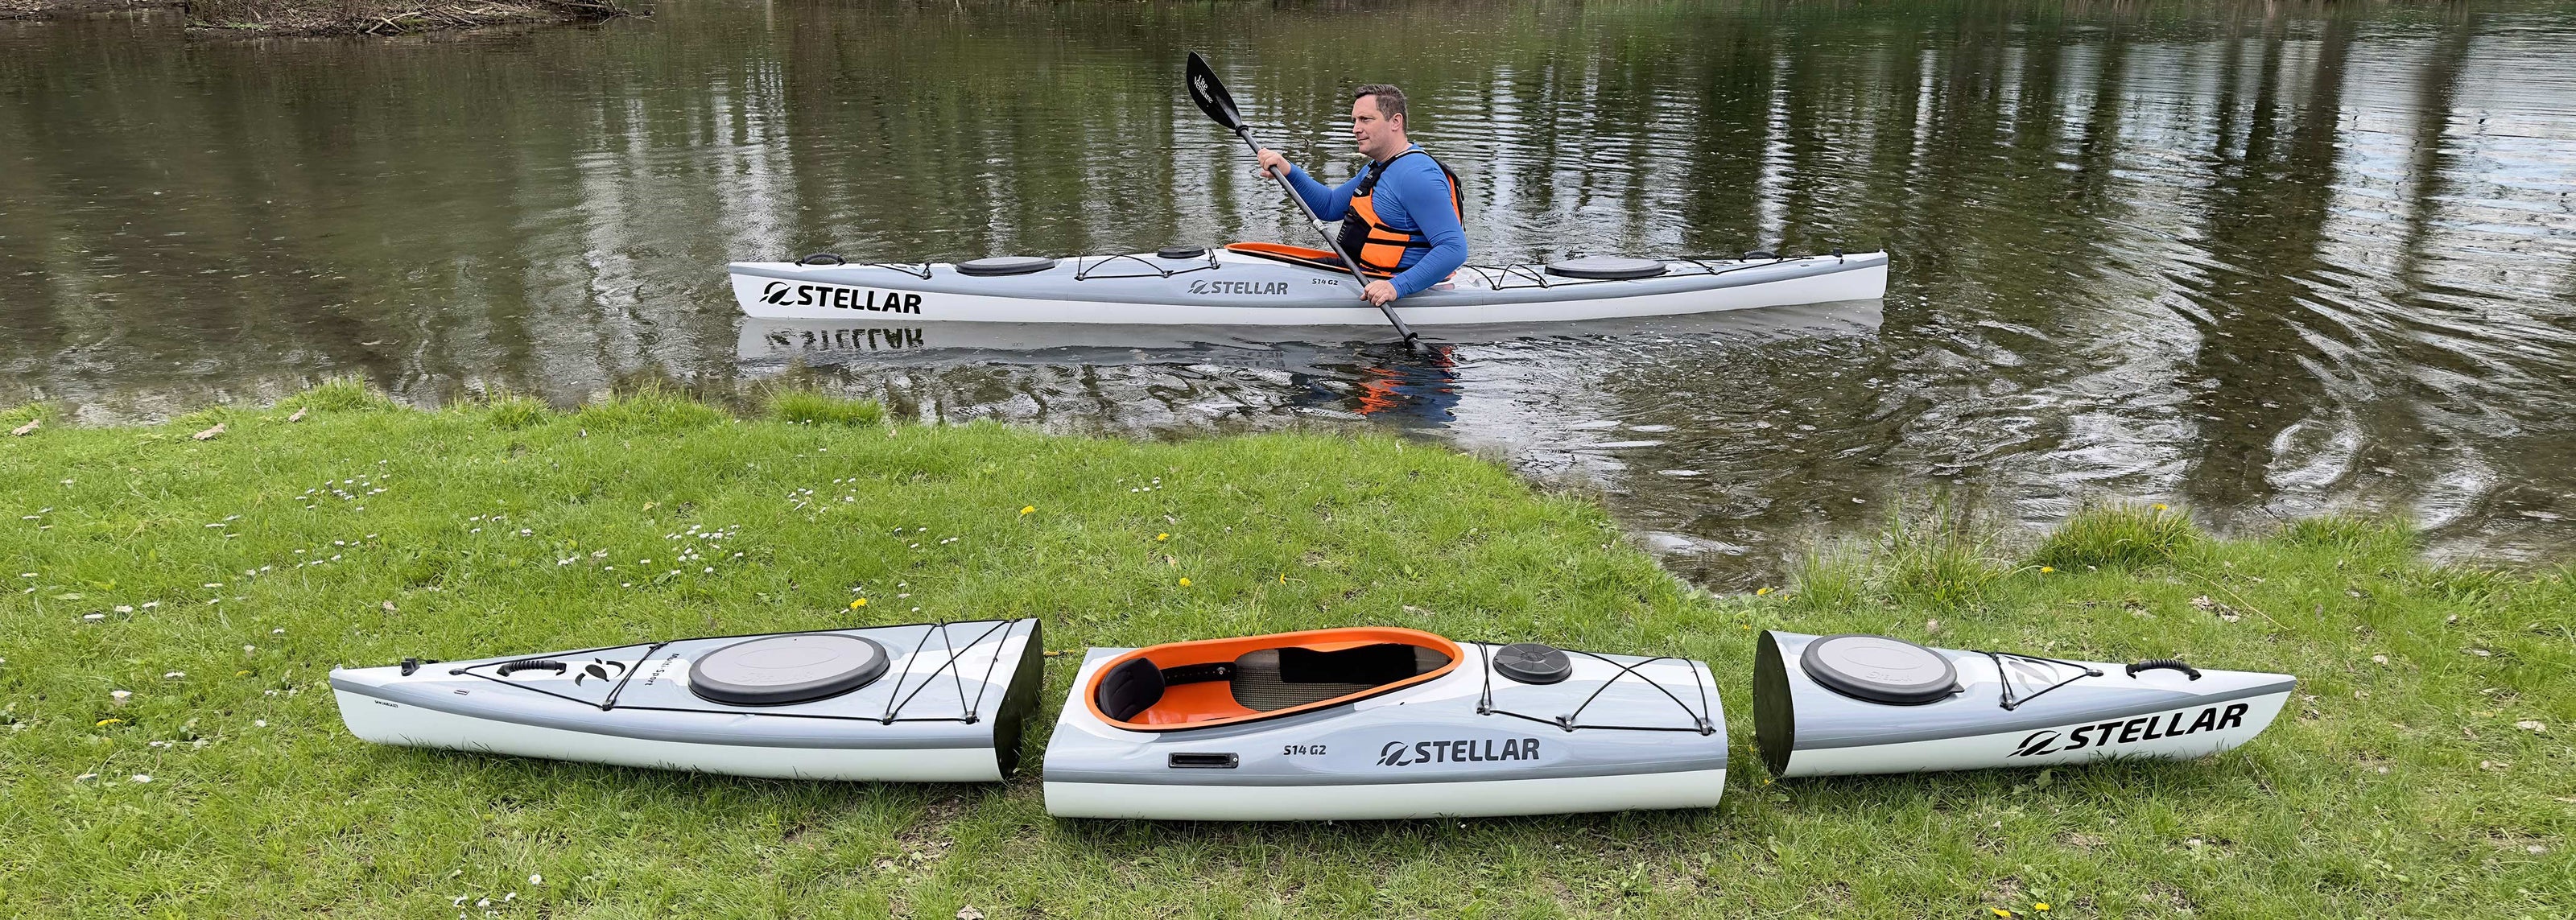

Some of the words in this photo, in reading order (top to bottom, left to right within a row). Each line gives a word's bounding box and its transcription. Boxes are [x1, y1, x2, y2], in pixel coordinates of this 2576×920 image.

[1194, 76, 1214, 104] Venture
[1195, 75, 1208, 90] Lite
[797, 285, 923, 315] STELLAR
[1211, 281, 1288, 295] STELLAR
[645, 653, 680, 686] Multi-Sport
[2063, 703, 2249, 751] STELLAR
[1283, 745, 1307, 756] S14
[1310, 745, 1327, 755] G2
[1414, 738, 1540, 763] STELLAR
